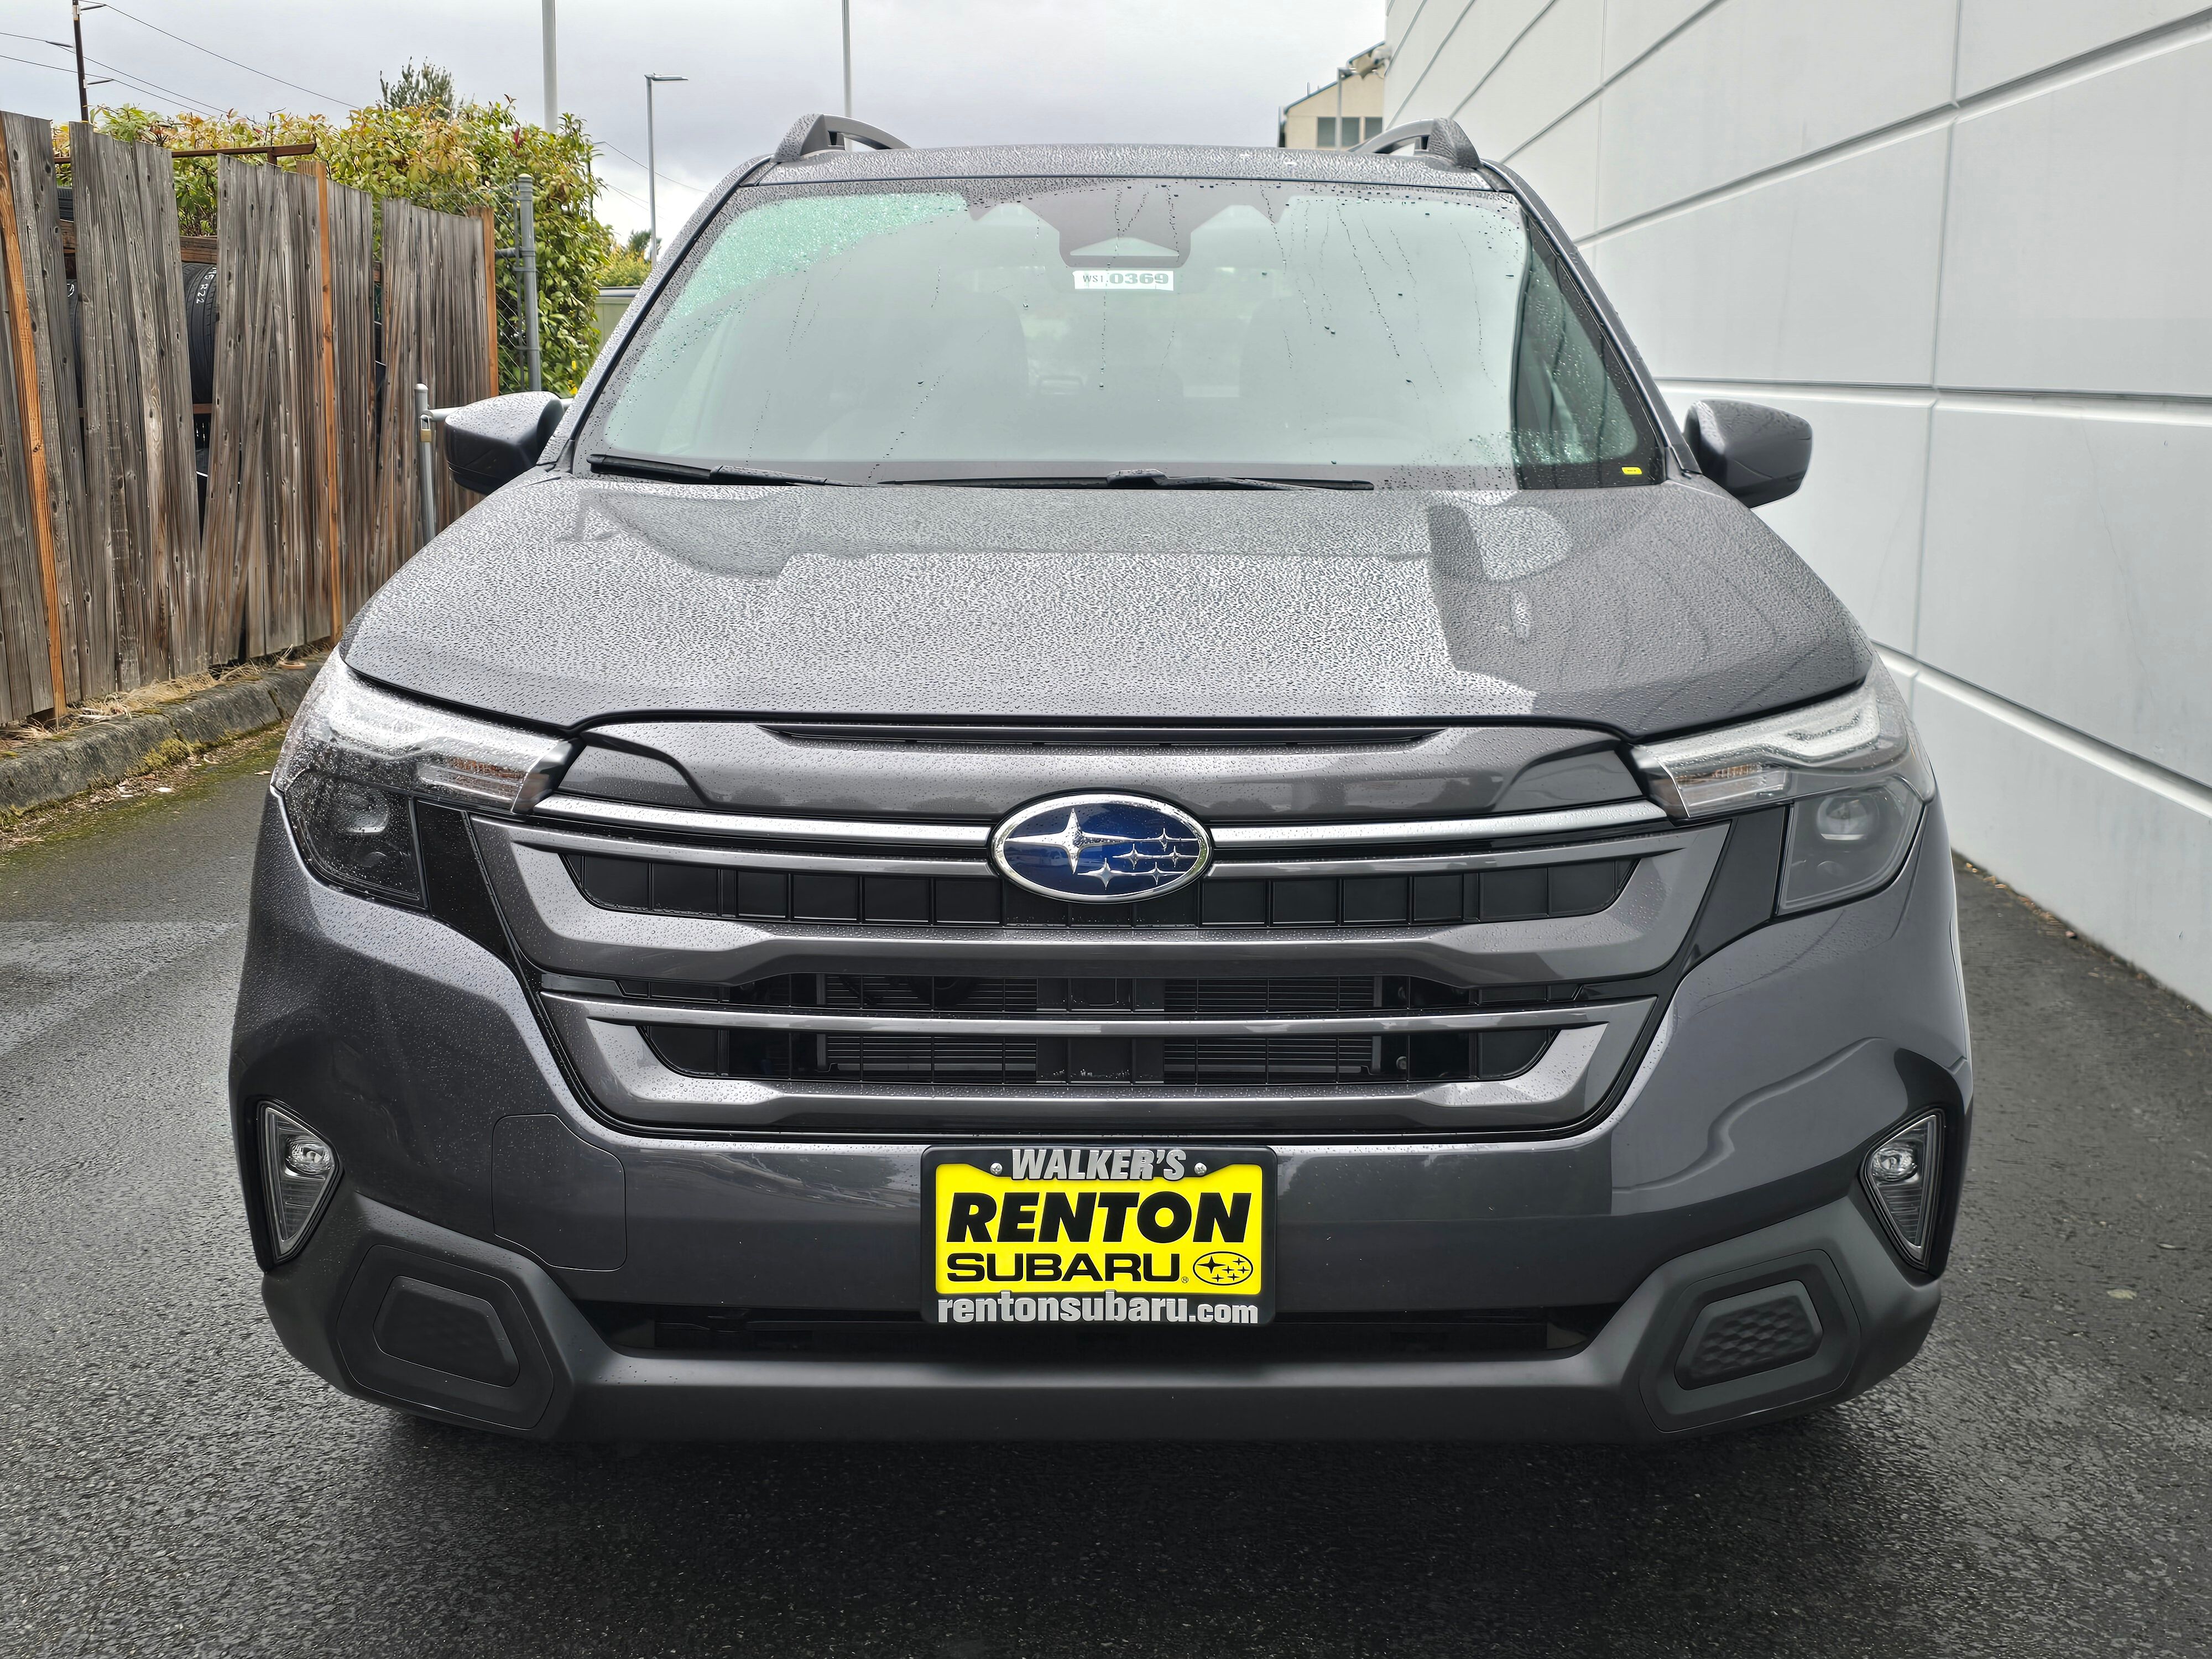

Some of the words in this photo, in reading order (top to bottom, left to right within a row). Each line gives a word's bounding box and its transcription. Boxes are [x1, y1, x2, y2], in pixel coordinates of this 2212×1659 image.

[1109, 273, 1169, 284] 0369
[1011, 1149, 1186, 1180] WALKER'S
[946, 1191, 1252, 1244] RENTON
[947, 1253, 1180, 1282] SUBARU
[938, 1290, 1258, 1324] rentonsubaru.com
